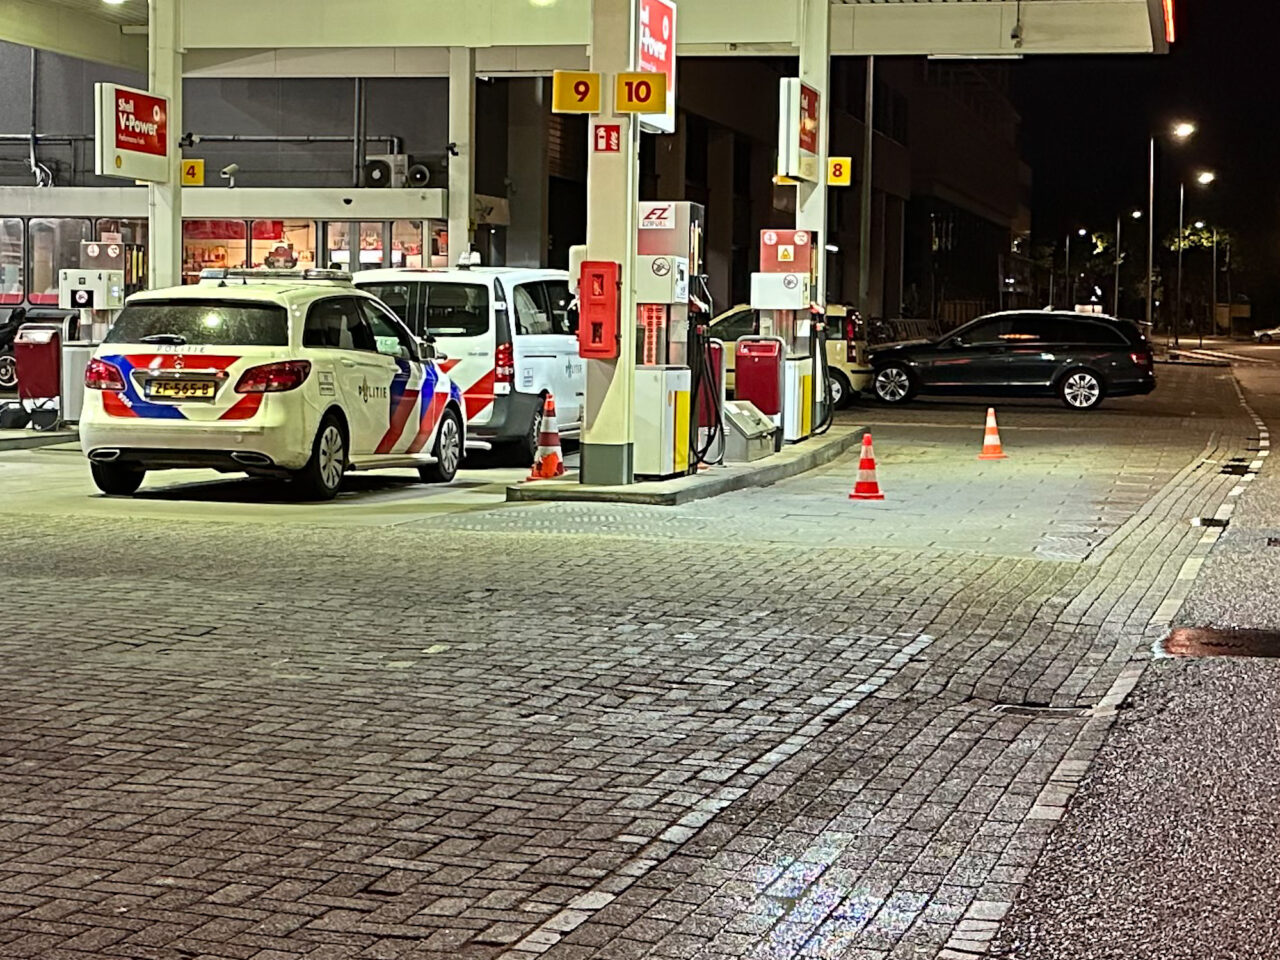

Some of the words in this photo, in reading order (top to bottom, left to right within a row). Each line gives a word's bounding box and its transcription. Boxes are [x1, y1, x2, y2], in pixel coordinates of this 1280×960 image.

[574, 80, 590, 102] 9
[625, 80, 652, 103] 10
[118, 111, 158, 136] V-Power
[186, 165, 196, 178] 4
[833, 163, 843, 177] 8
